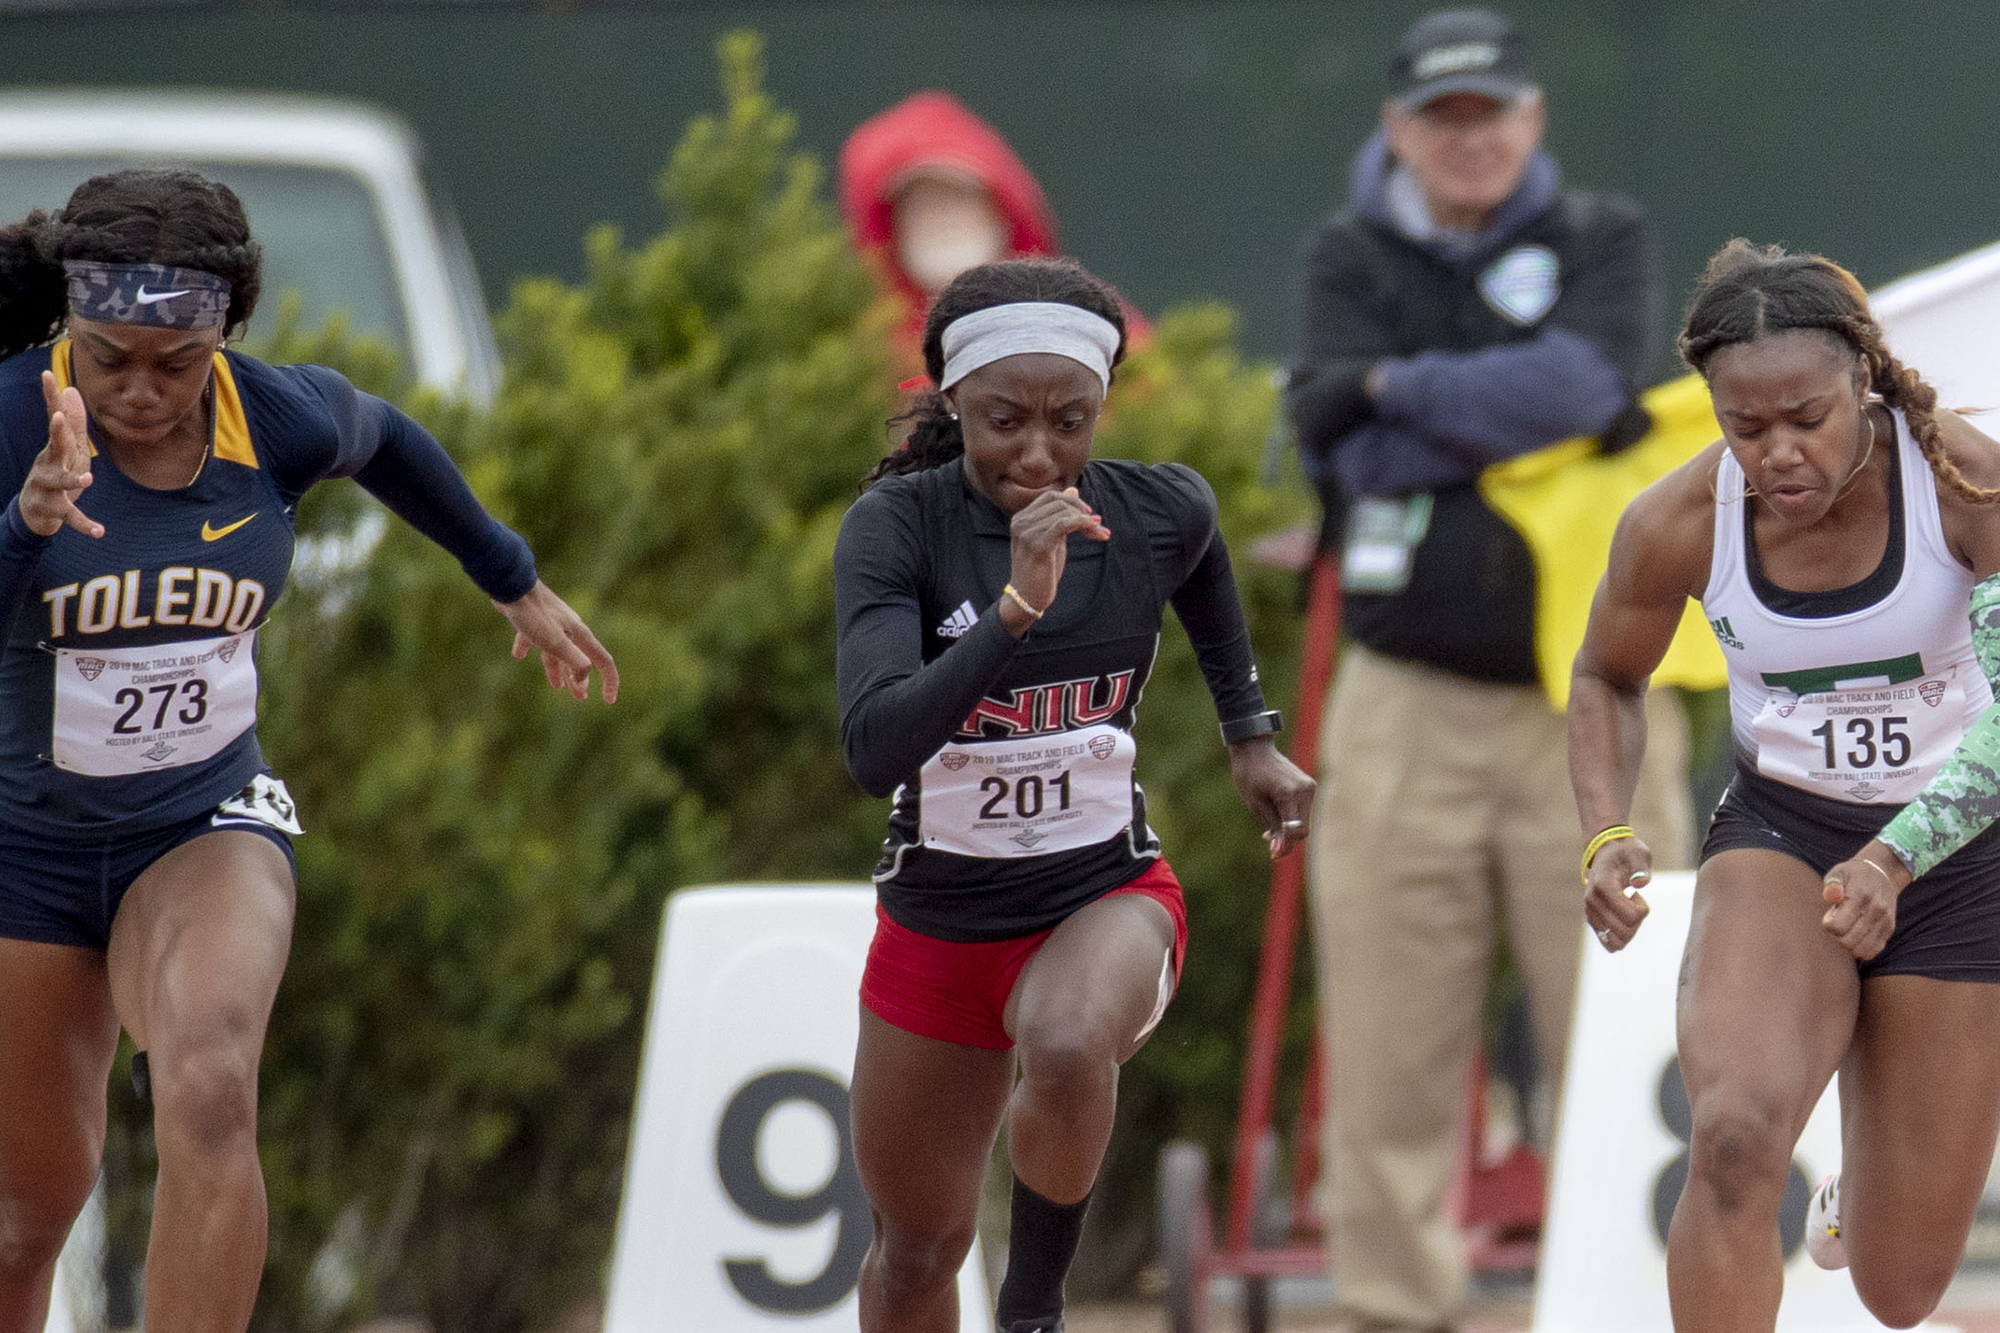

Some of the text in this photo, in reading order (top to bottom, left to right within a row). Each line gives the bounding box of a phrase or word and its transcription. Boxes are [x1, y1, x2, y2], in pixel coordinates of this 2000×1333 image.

[43, 566, 265, 638] TOLEDO
[109, 661, 131, 671] 2019
[132, 661, 151, 671] MAC
[152, 657, 178, 669] TRACK
[179, 655, 195, 666] AND
[131, 668, 196, 685] CHAMPIONSHIPS
[956, 668, 1135, 737] NIU
[1826, 694, 1844, 704] MAC
[1846, 692, 1873, 703] TRACK
[1874, 690, 1892, 701] AND
[1893, 688, 1915, 700] FIELD
[113, 679, 209, 734] 273
[1826, 704, 1894, 716] CHAMPIONSHIPS
[141, 733, 157, 744] BALL
[158, 731, 177, 741] STATE
[1812, 717, 1911, 769] 135
[996, 753, 1015, 763] MAC
[1017, 751, 1043, 762] TRACK
[1044, 747, 1062, 759] AND
[1063, 743, 1085, 756] FIELD
[996, 759, 1063, 775] CHAMPIONSHIPS
[1861, 771, 1881, 780] STATE
[1882, 766, 1919, 780] UNIVERSITY
[979, 769, 1071, 819] 201
[716, 1066, 872, 1316] 9
